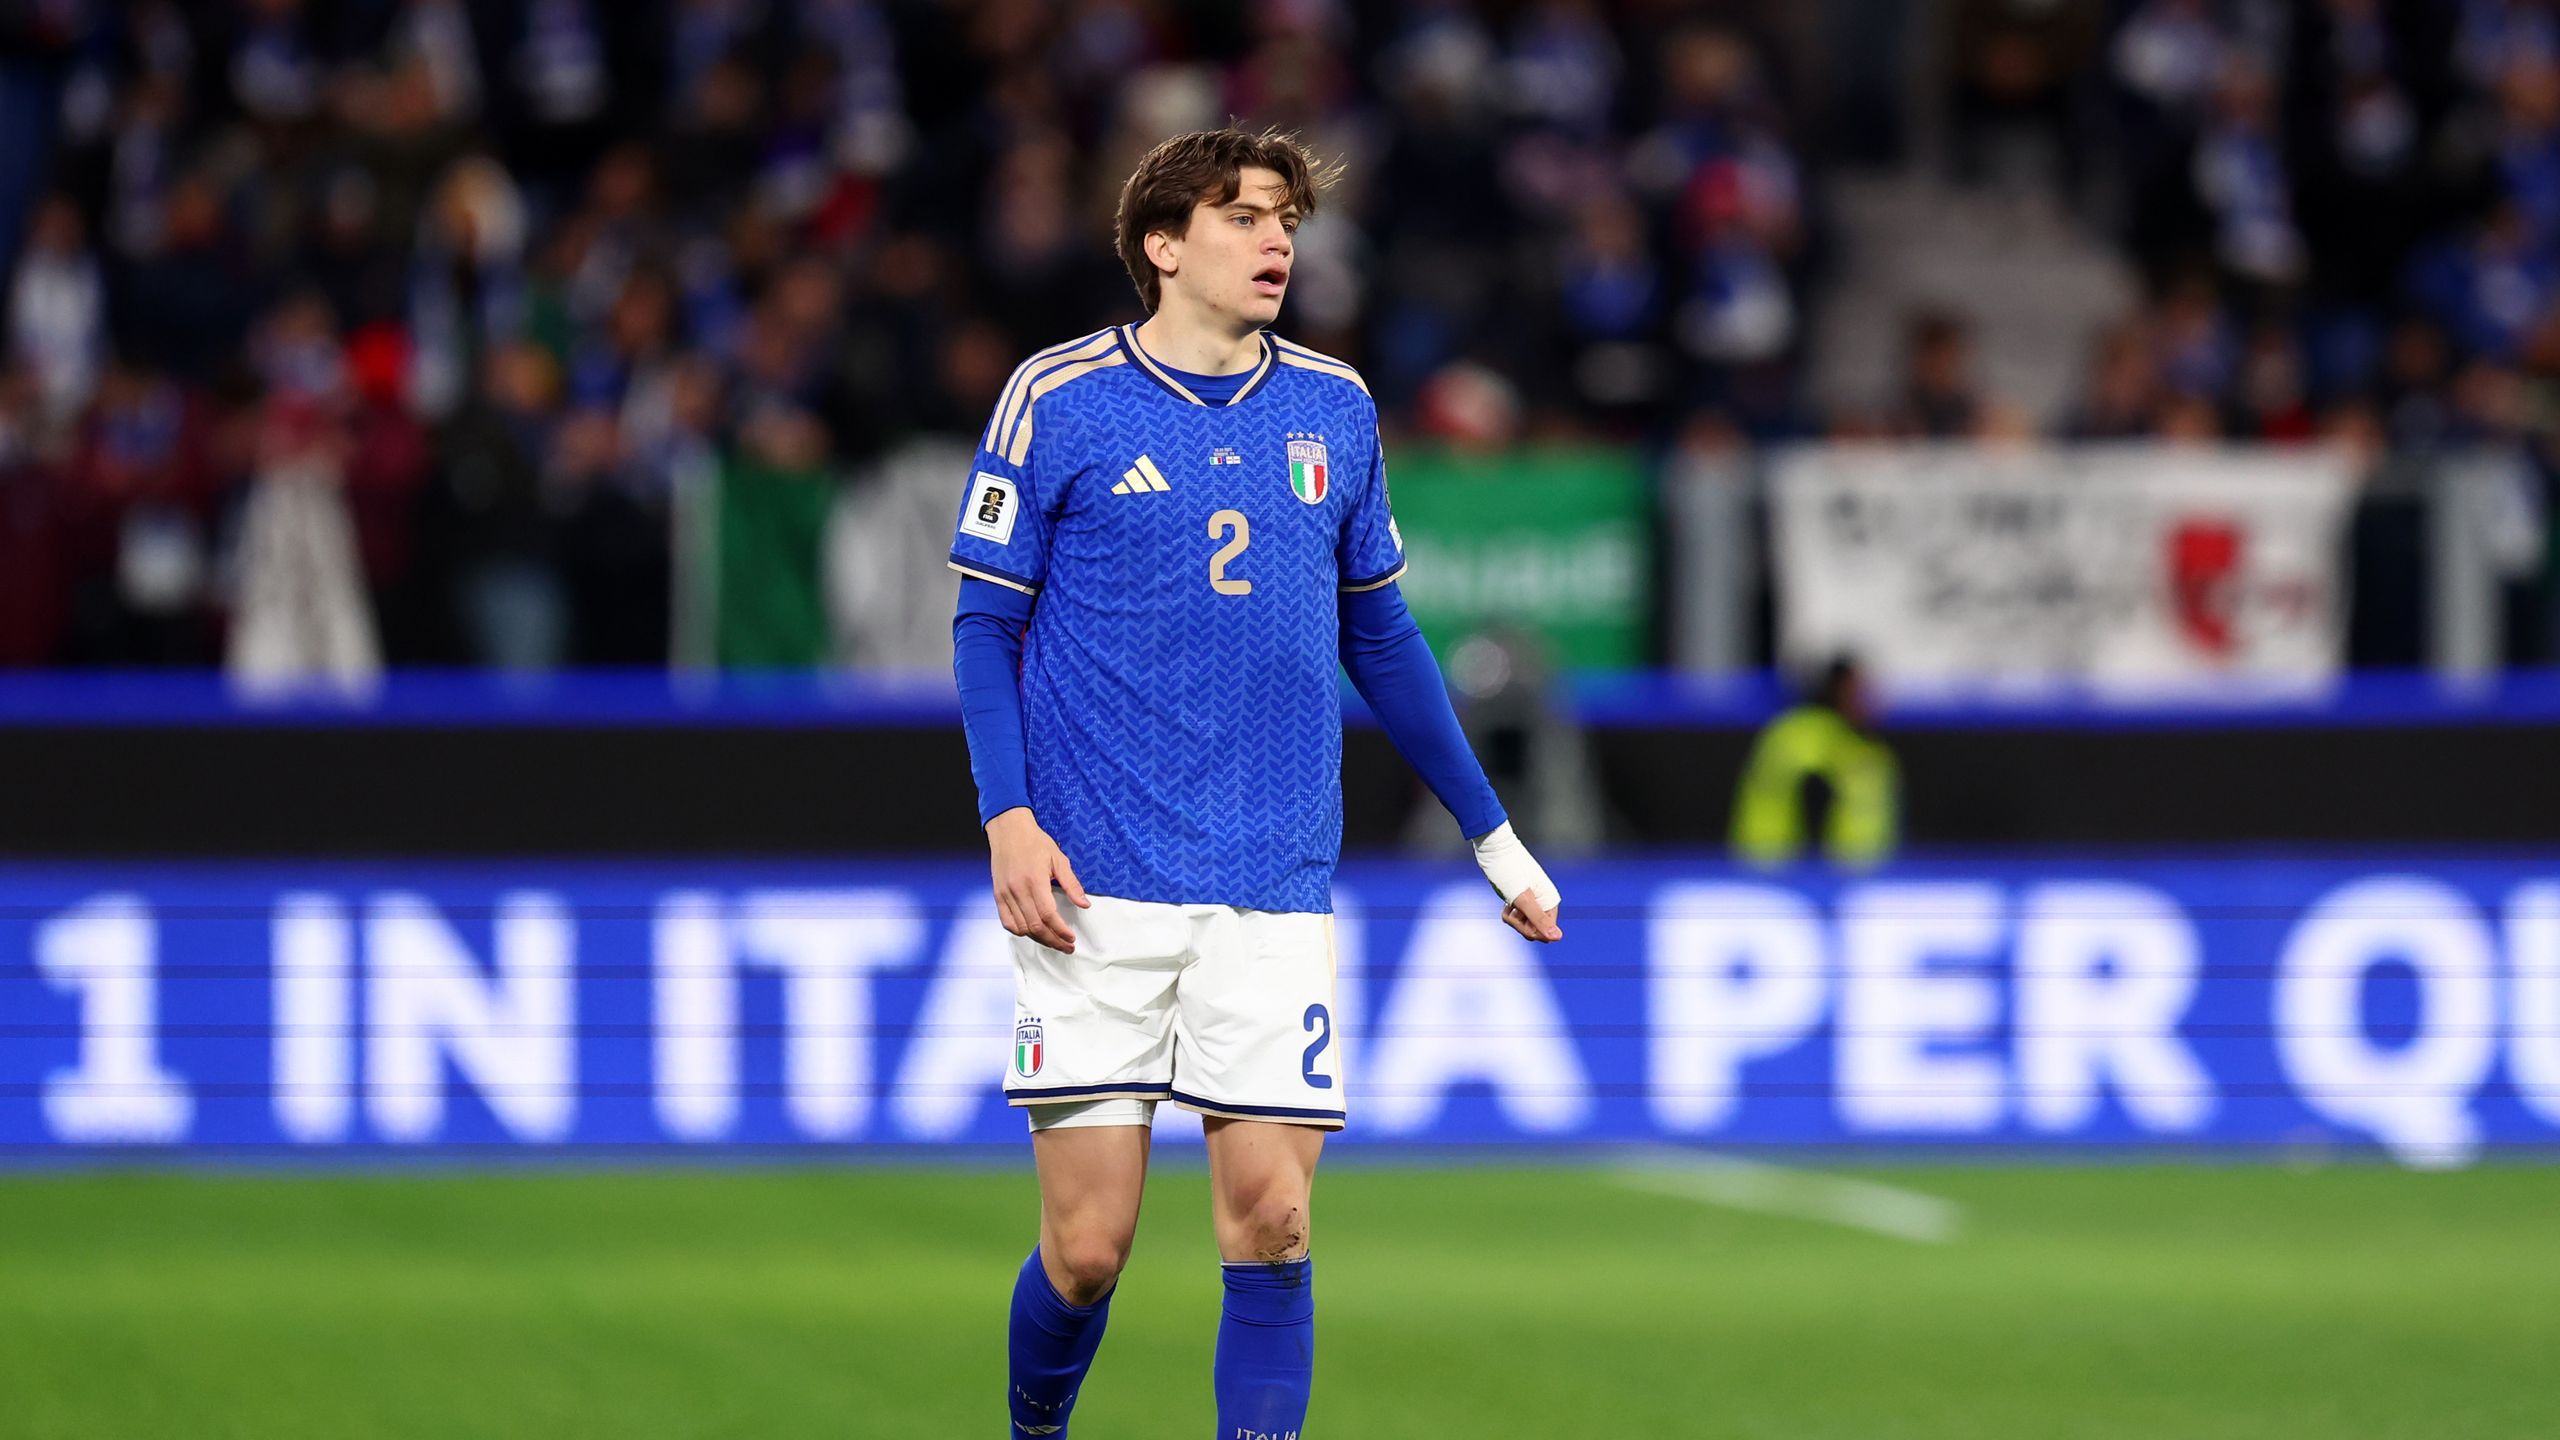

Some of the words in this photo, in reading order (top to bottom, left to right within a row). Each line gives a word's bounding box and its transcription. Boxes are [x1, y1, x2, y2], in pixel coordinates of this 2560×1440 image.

[1290, 445, 1323, 461] ITALIA
[1208, 509, 1252, 596] 2
[35, 889, 194, 1143] 1
[272, 889, 579, 1143] IN
[650, 887, 1593, 1143] ITAA
[1648, 880, 2216, 1134] PER
[1018, 1029, 1040, 1040] ITALIA
[1302, 1003, 1332, 1089] 2
